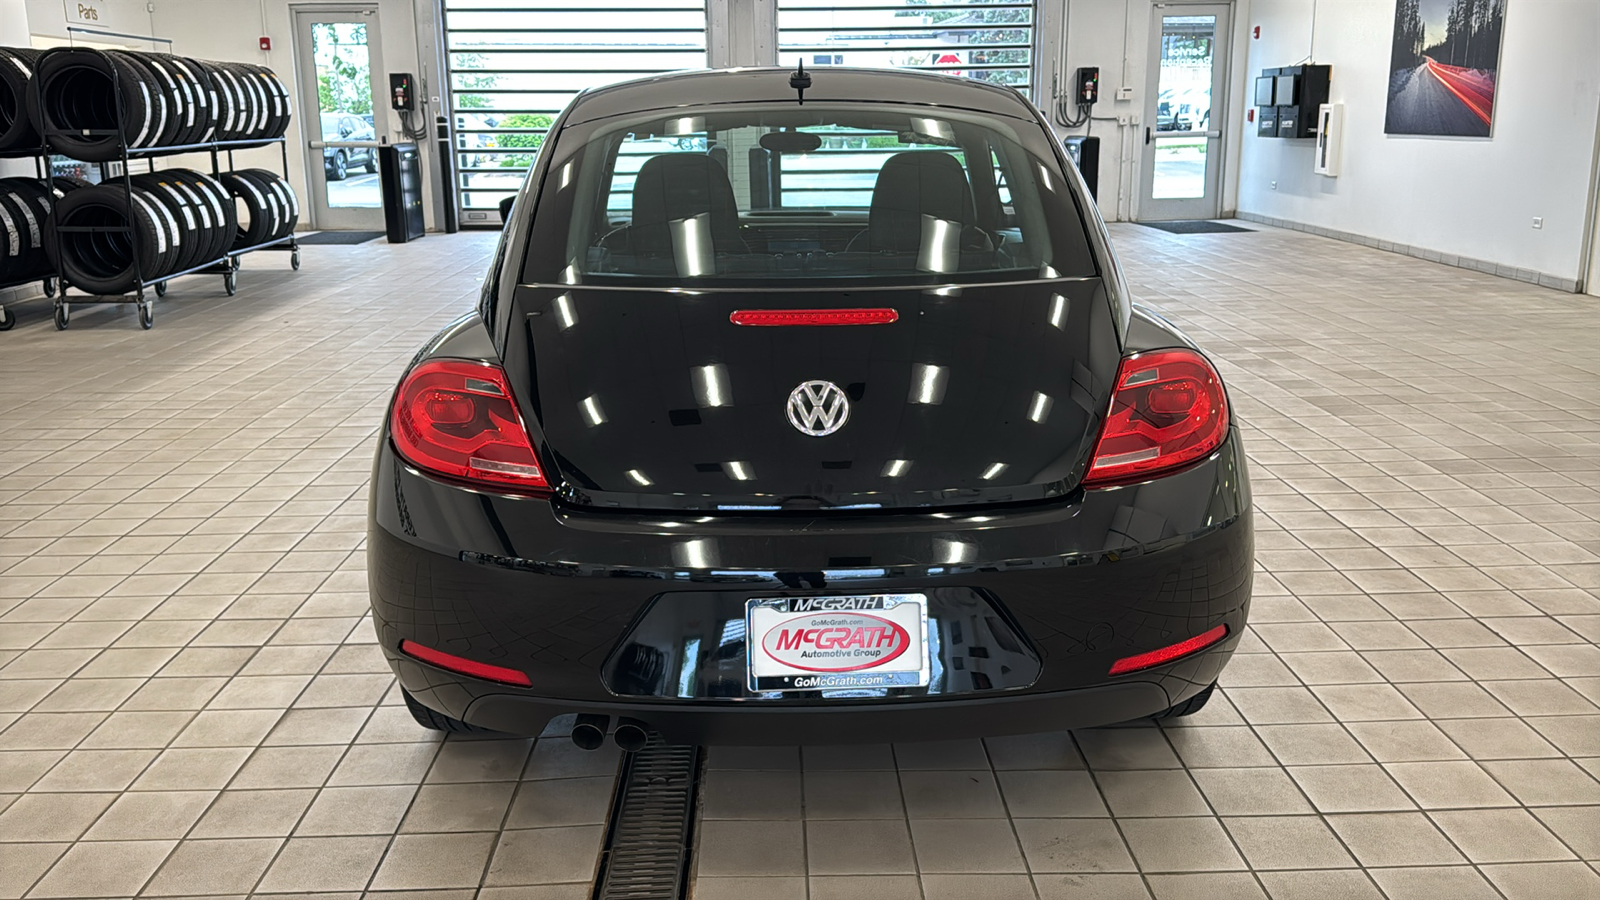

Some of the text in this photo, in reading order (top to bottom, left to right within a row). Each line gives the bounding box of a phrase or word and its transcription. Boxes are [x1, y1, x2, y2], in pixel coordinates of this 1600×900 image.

[78, 3, 98, 20] Parts
[801, 649, 881, 658] Automotive Group
[794, 676, 883, 687] GoMcGrath.com
